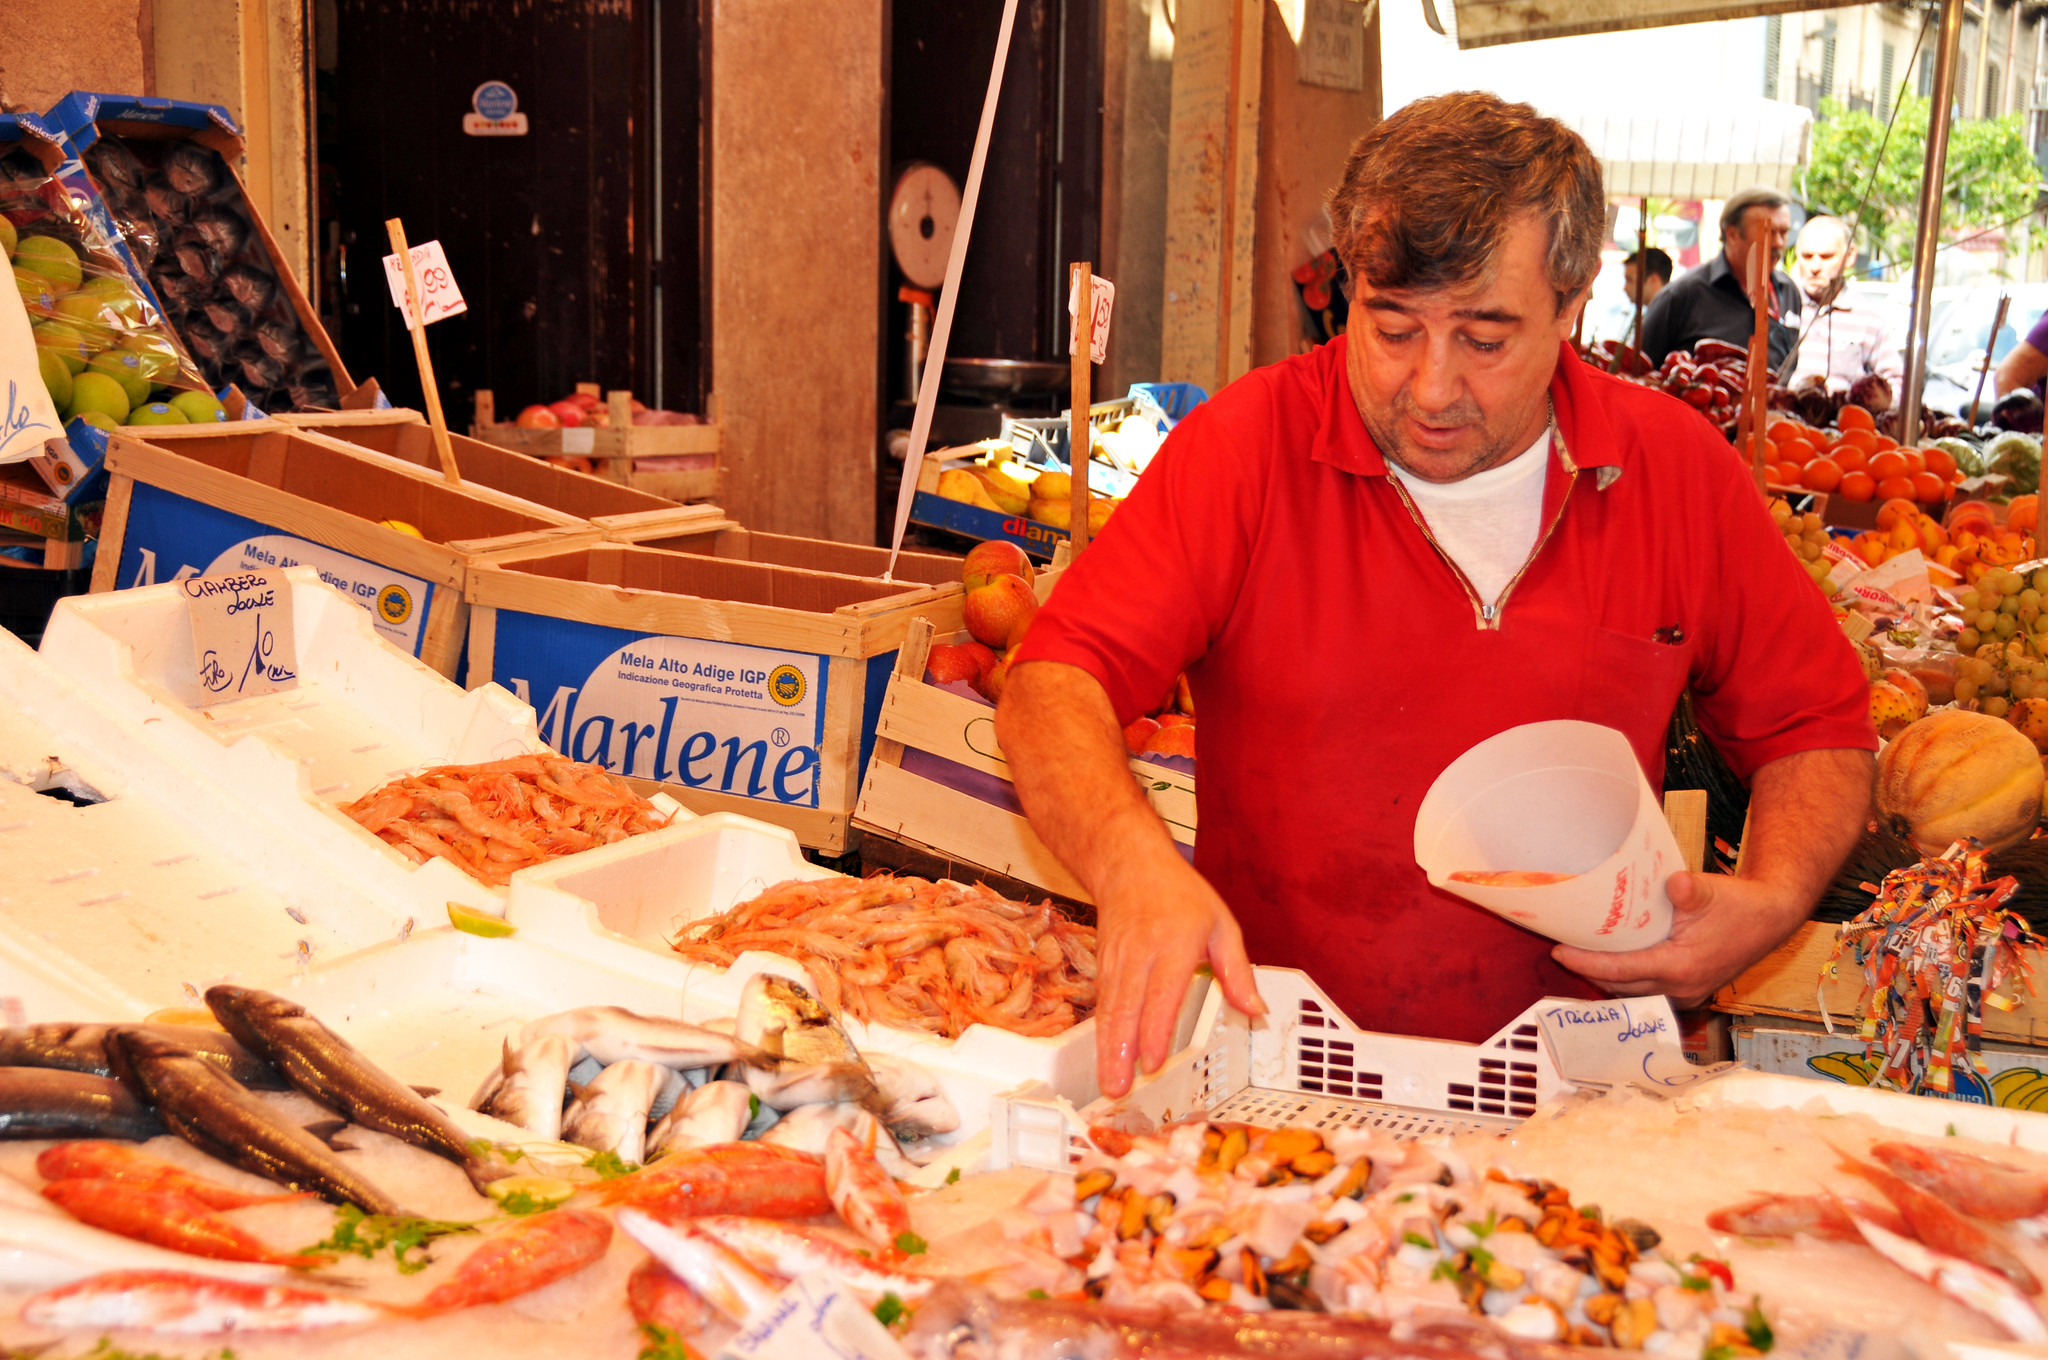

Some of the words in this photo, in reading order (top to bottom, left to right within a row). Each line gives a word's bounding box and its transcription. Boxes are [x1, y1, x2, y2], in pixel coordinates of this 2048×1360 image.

[244, 543, 277, 566] Mela
[317, 571, 349, 591] dige
[351, 581, 378, 599] IGP
[617, 670, 670, 687] Indicazione
[671, 678, 723, 694] Geografica
[725, 686, 764, 700] Protetta
[620, 651, 655, 670] Mela
[659, 657, 689, 674] Alto
[693, 662, 736, 682] Adige
[740, 669, 767, 685] IGP
[510, 677, 819, 804] Marlene
